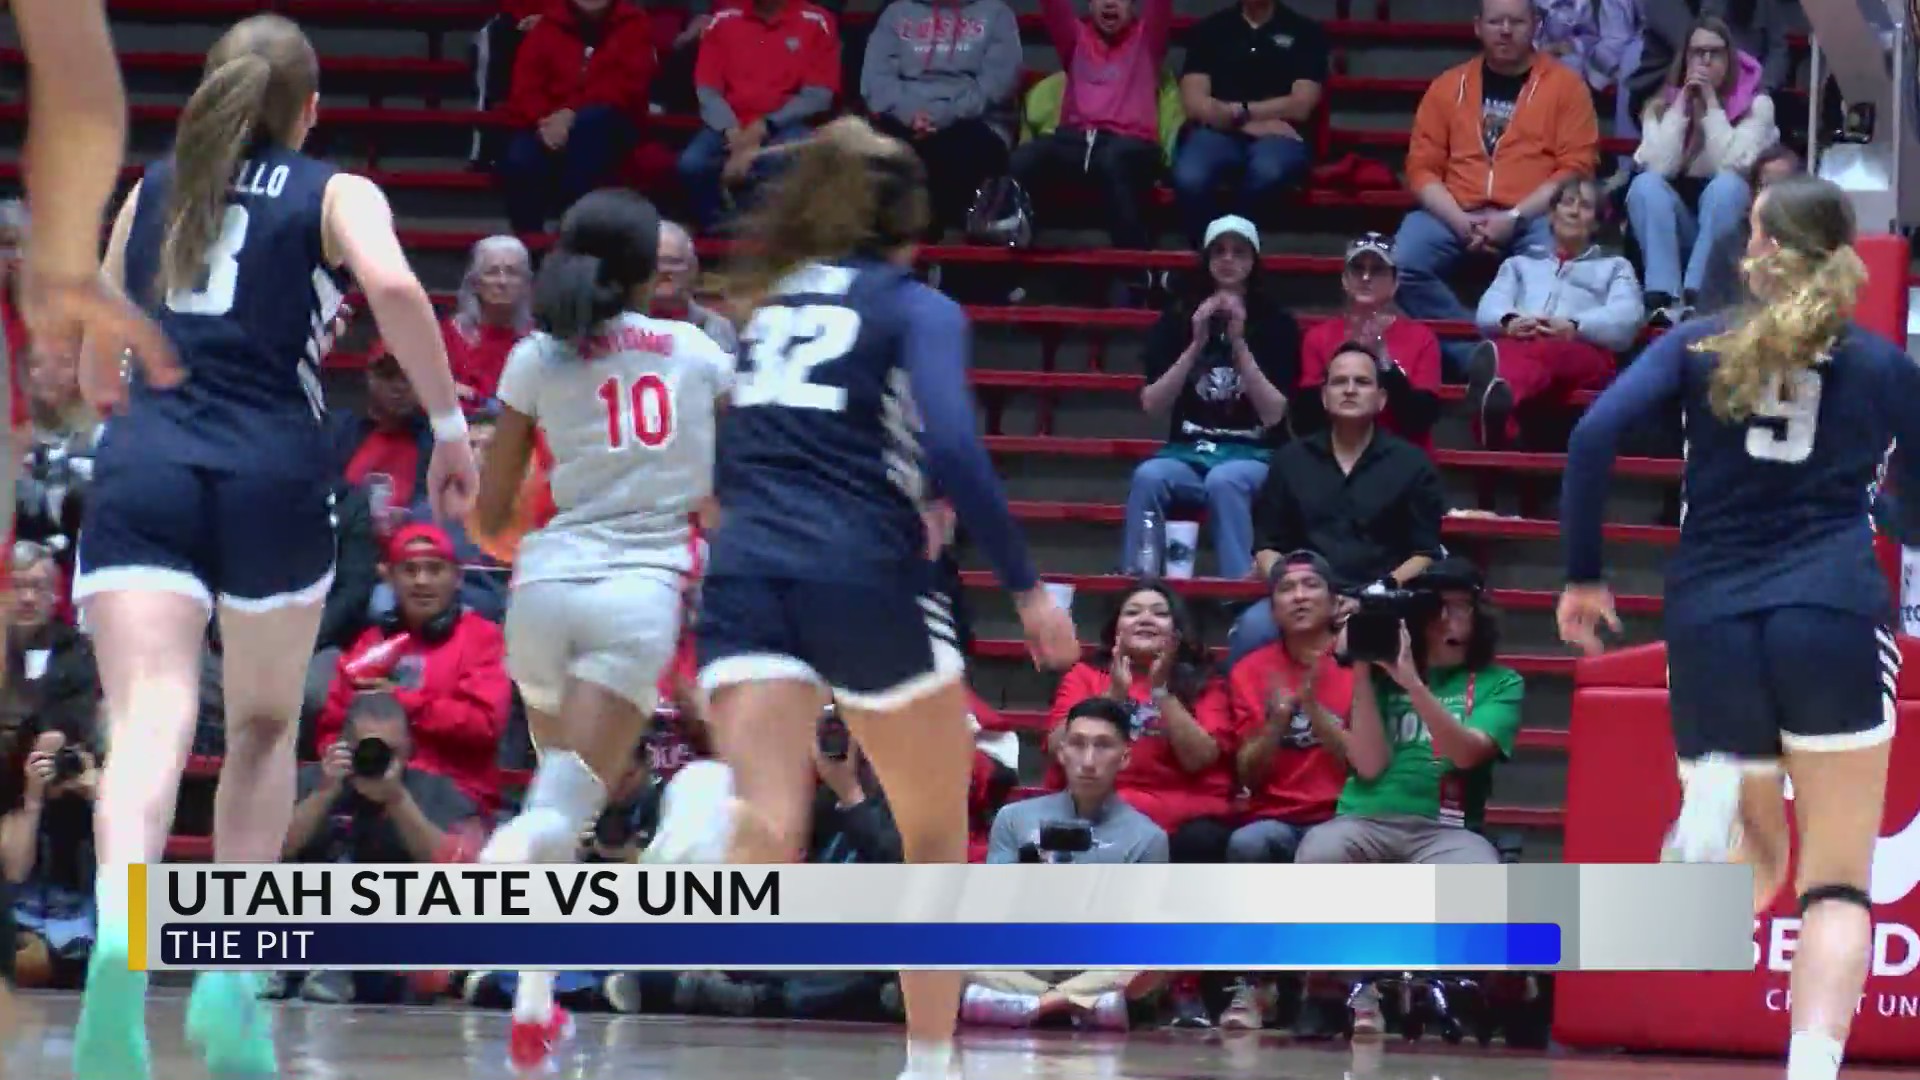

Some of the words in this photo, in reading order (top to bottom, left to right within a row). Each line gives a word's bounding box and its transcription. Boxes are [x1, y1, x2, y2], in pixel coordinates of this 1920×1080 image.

[732, 305, 861, 411] 32
[597, 373, 674, 450] 10
[1744, 367, 1822, 463] 9
